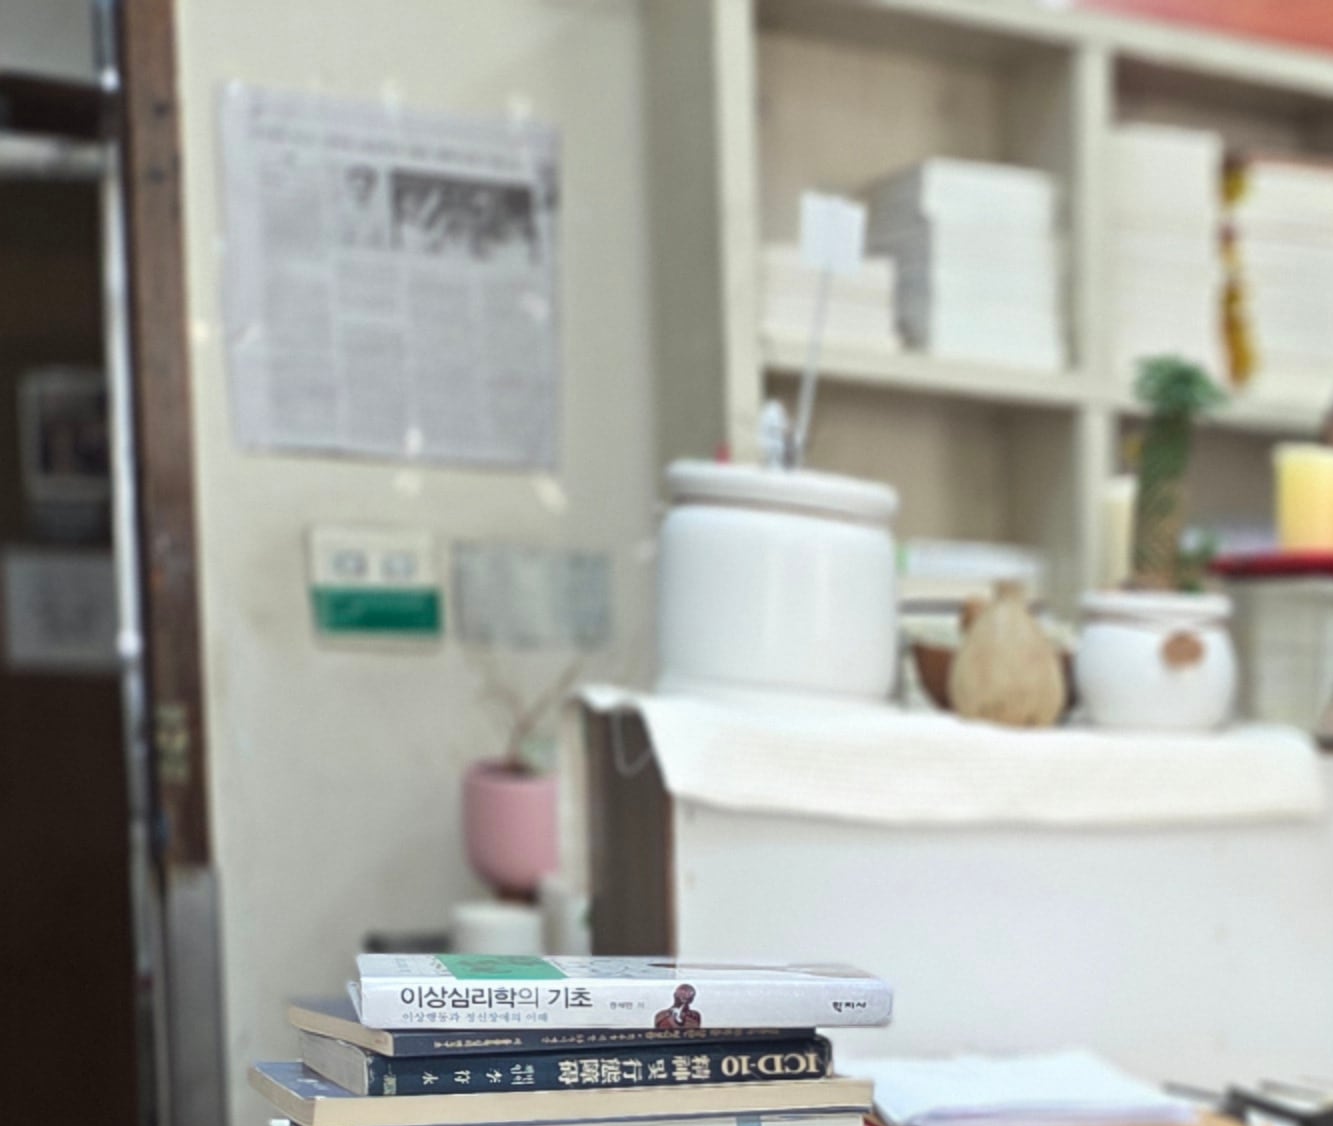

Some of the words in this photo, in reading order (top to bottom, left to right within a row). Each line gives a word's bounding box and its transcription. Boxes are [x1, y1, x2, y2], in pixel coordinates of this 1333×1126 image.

[400, 987, 539, 1009] 이상심리학의
[547, 988, 592, 1008] 기초
[721, 1053, 821, 1076] ICD-10
